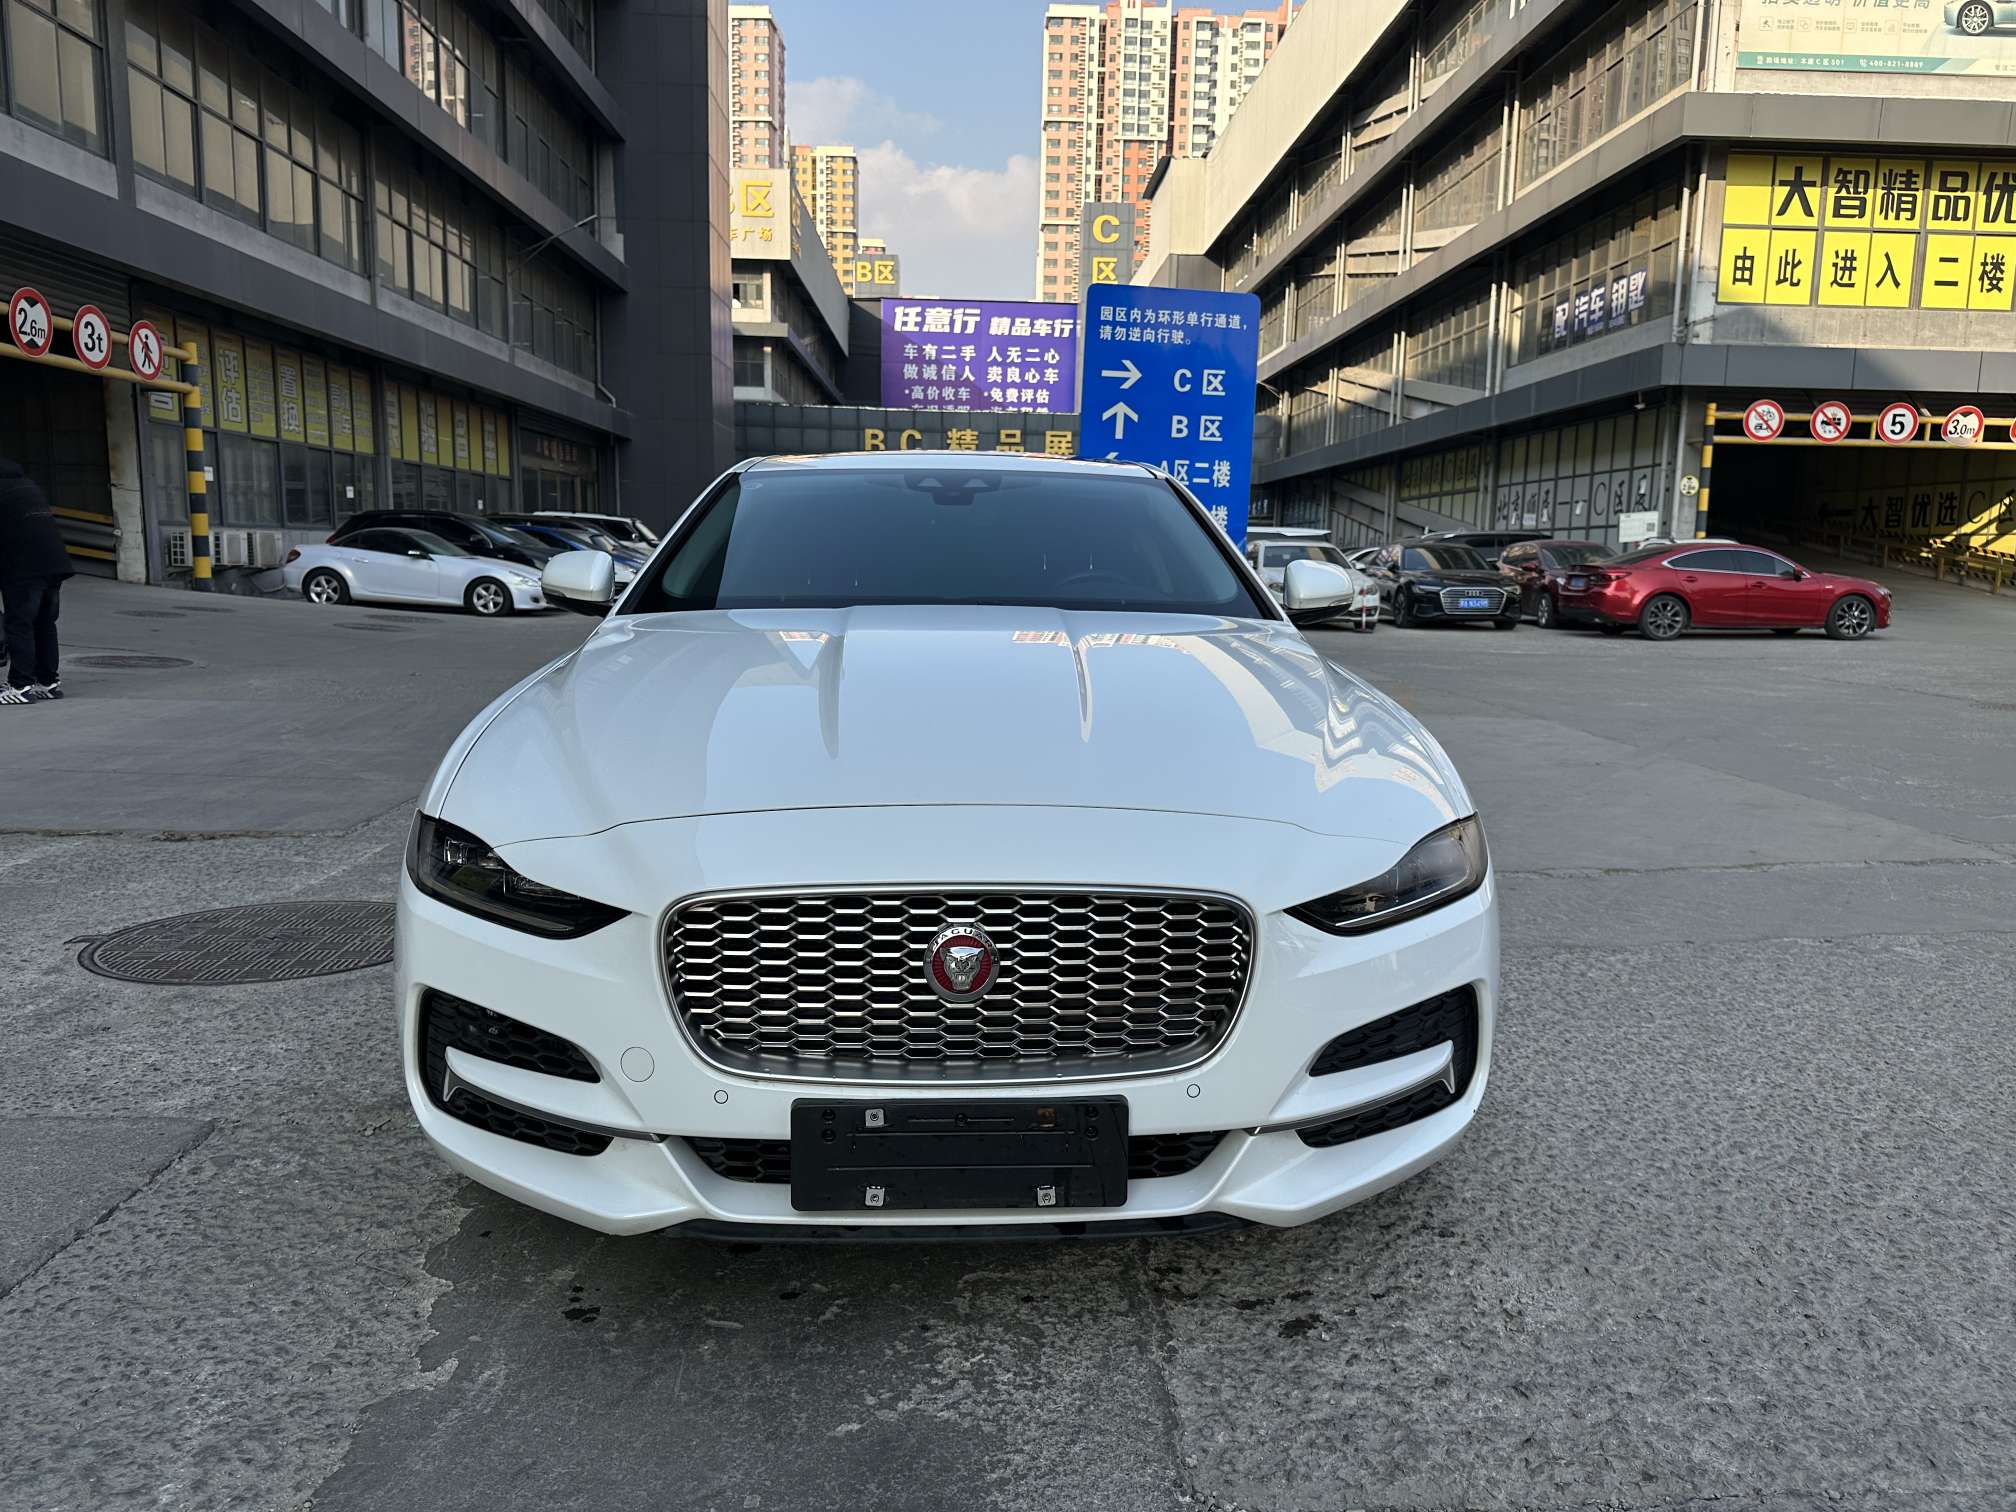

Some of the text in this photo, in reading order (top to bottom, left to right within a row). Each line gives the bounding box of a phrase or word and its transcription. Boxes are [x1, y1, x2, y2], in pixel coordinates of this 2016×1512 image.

[729, 180, 775, 218] 区
[1776, 166, 2016, 223] 大智精品优
[855, 261, 896, 285] B区
[1732, 246, 2005, 293] 由此进入二楼
[17, 307, 47, 339] 2.6m
[893, 305, 1075, 338] 任意行 精品车行
[1100, 306, 1248, 330] 园区内为环形单行通道，
[83, 320, 104, 353] 3t
[1099, 325, 1192, 346] 请勿逆向行驶。
[903, 344, 1060, 364] 车有二手 人无二心
[903, 364, 1060, 384] 做诚信人 卖良心车
[1889, 413, 1905, 435] 5
[1948, 418, 1976, 437] 3.0m
